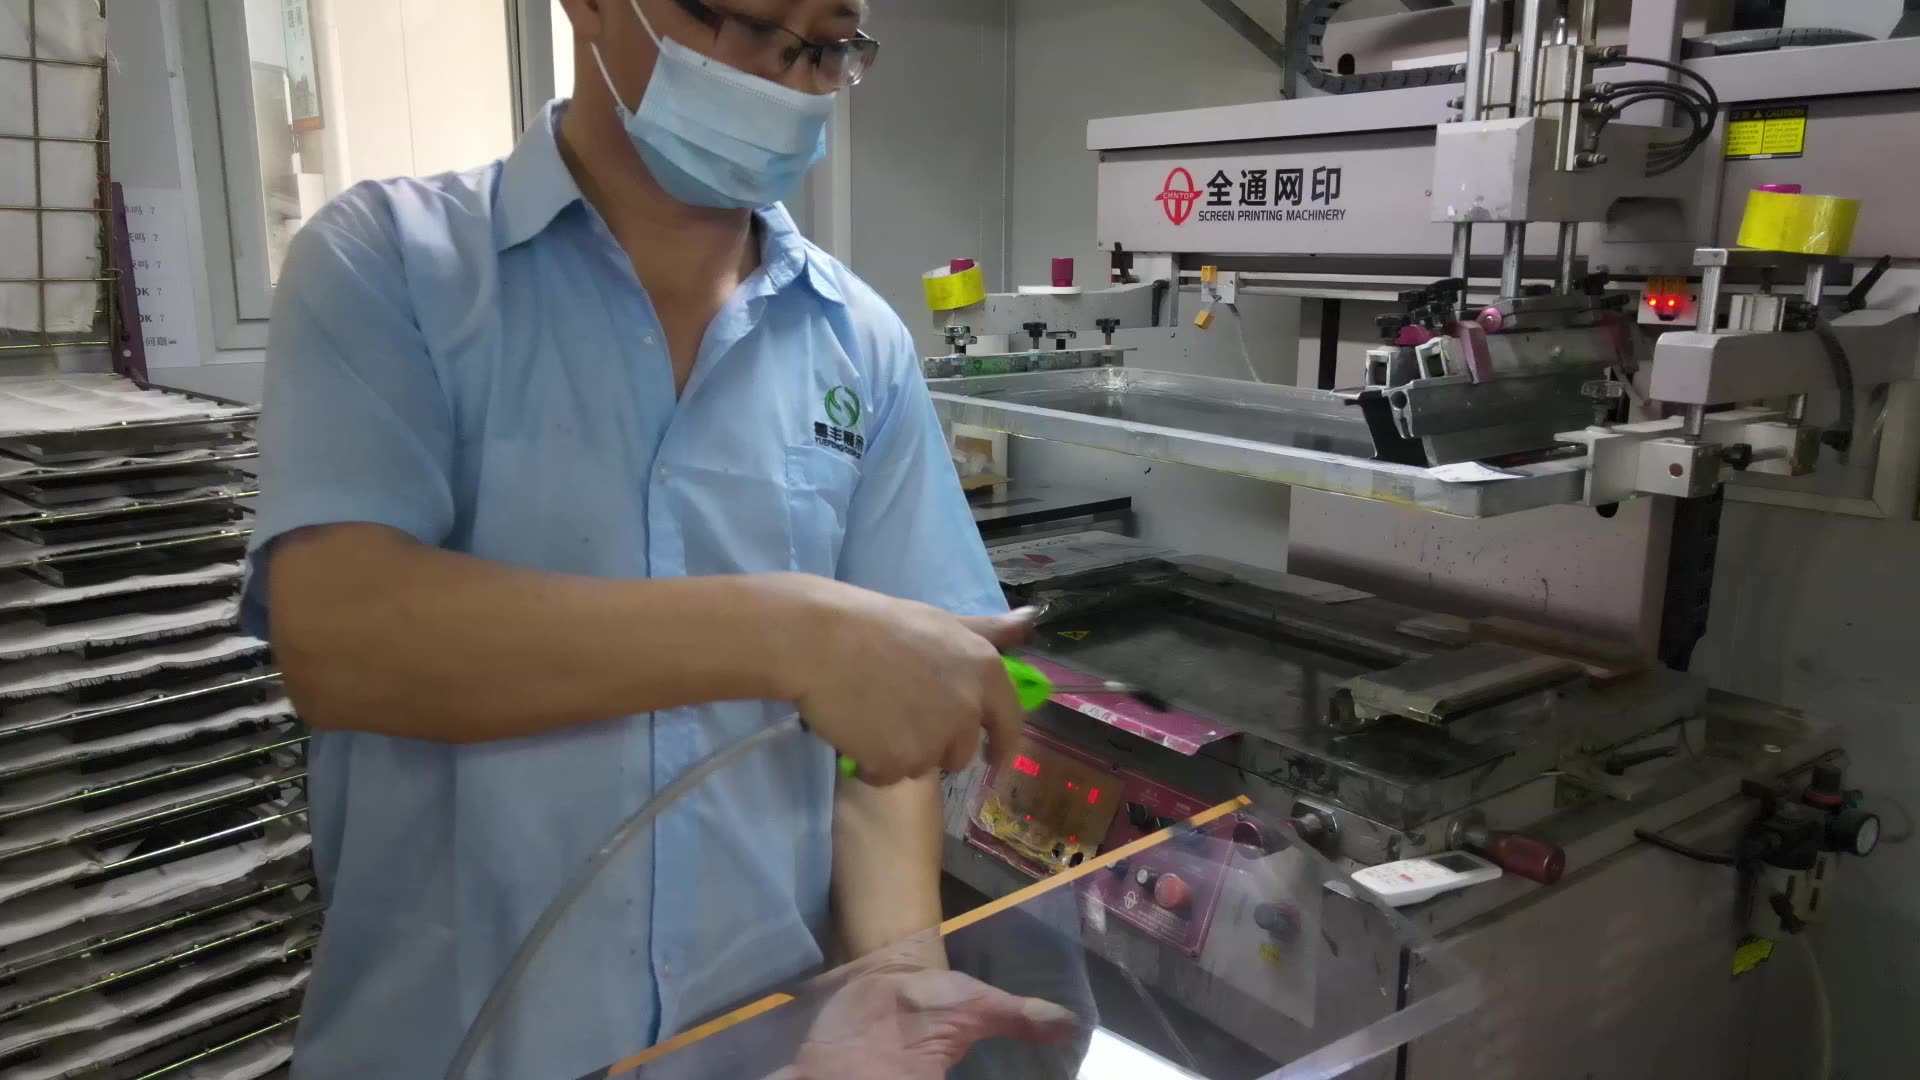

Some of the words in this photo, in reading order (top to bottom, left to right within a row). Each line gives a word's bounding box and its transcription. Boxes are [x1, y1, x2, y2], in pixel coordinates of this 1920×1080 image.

[1206, 165, 1342, 207] 全通网印
[1163, 191, 1195, 200] CHNTOP
[1198, 209, 1235, 222] SCREEN
[1237, 209, 1283, 222] PRINTING
[1286, 208, 1346, 221] MACHINERY
